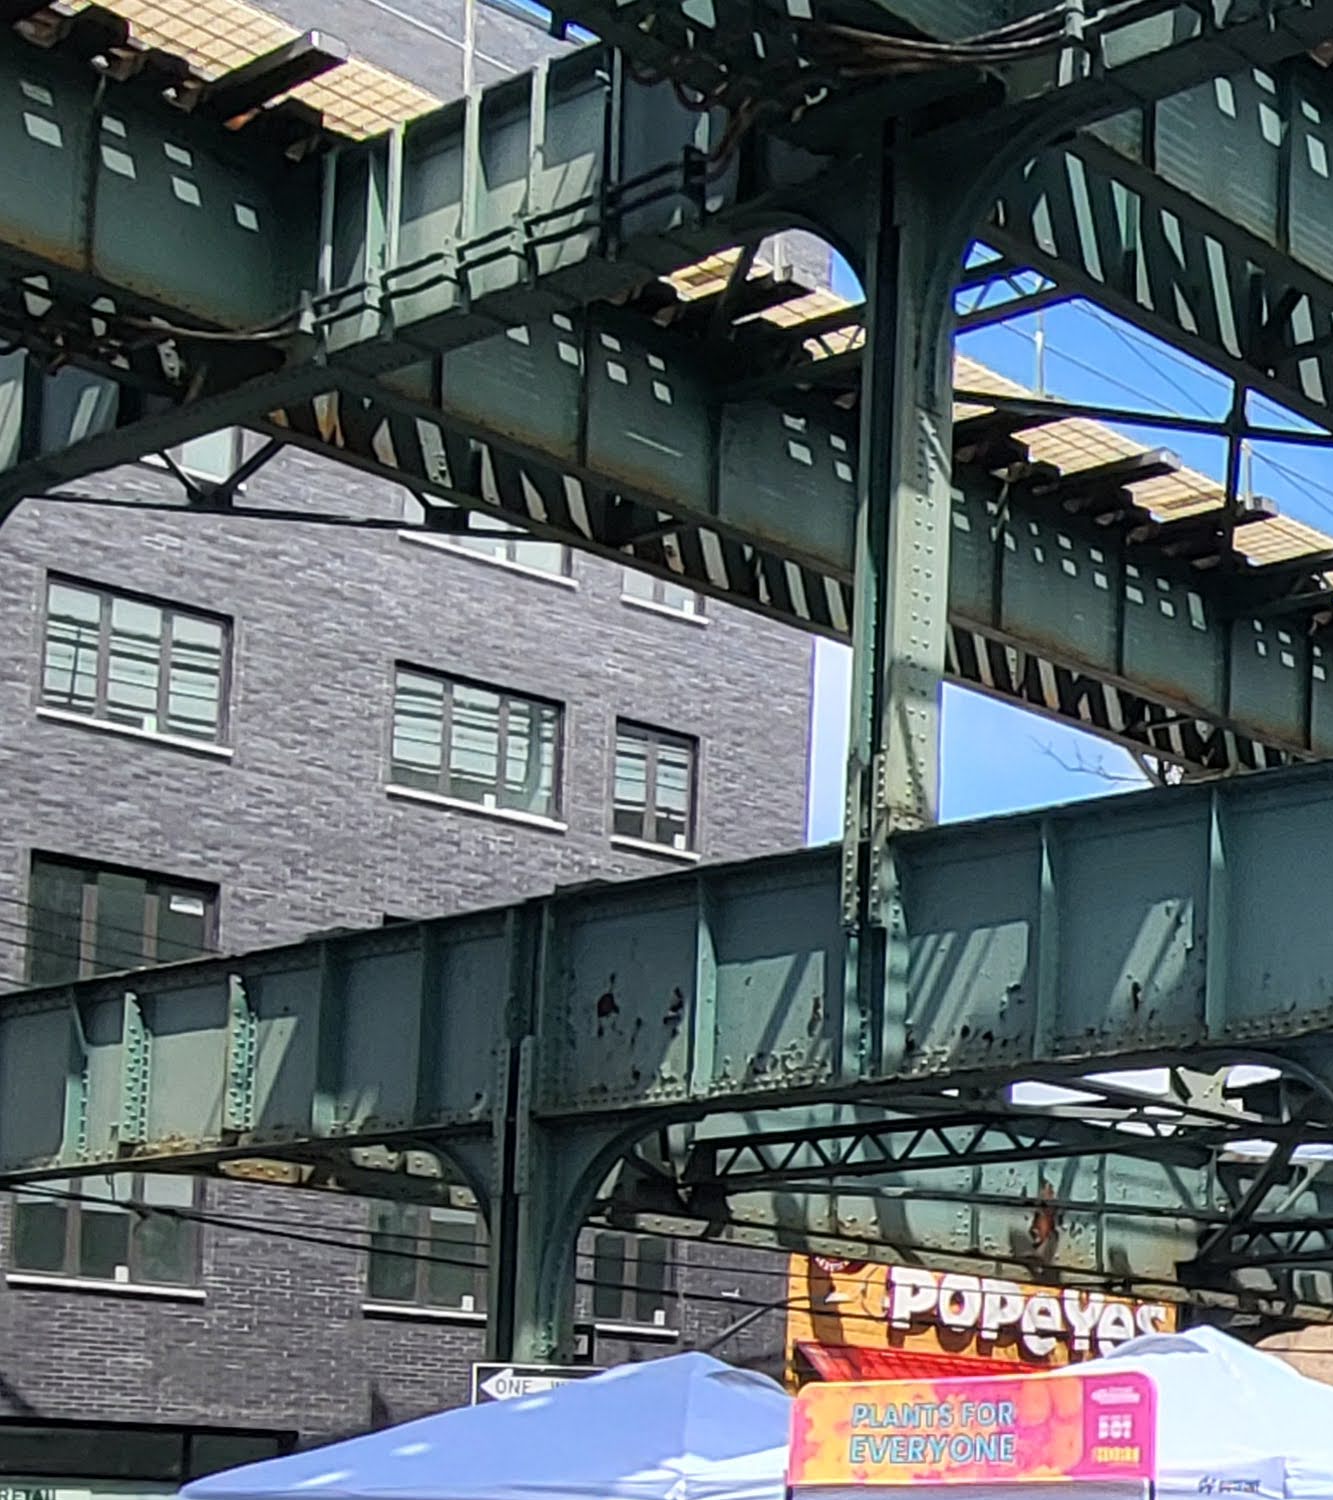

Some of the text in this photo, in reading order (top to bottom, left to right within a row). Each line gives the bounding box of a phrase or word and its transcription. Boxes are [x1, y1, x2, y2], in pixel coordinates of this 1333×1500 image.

[852, 1400, 1015, 1428] PLANTS FOR
[848, 1432, 1016, 1463] EVERYONE
